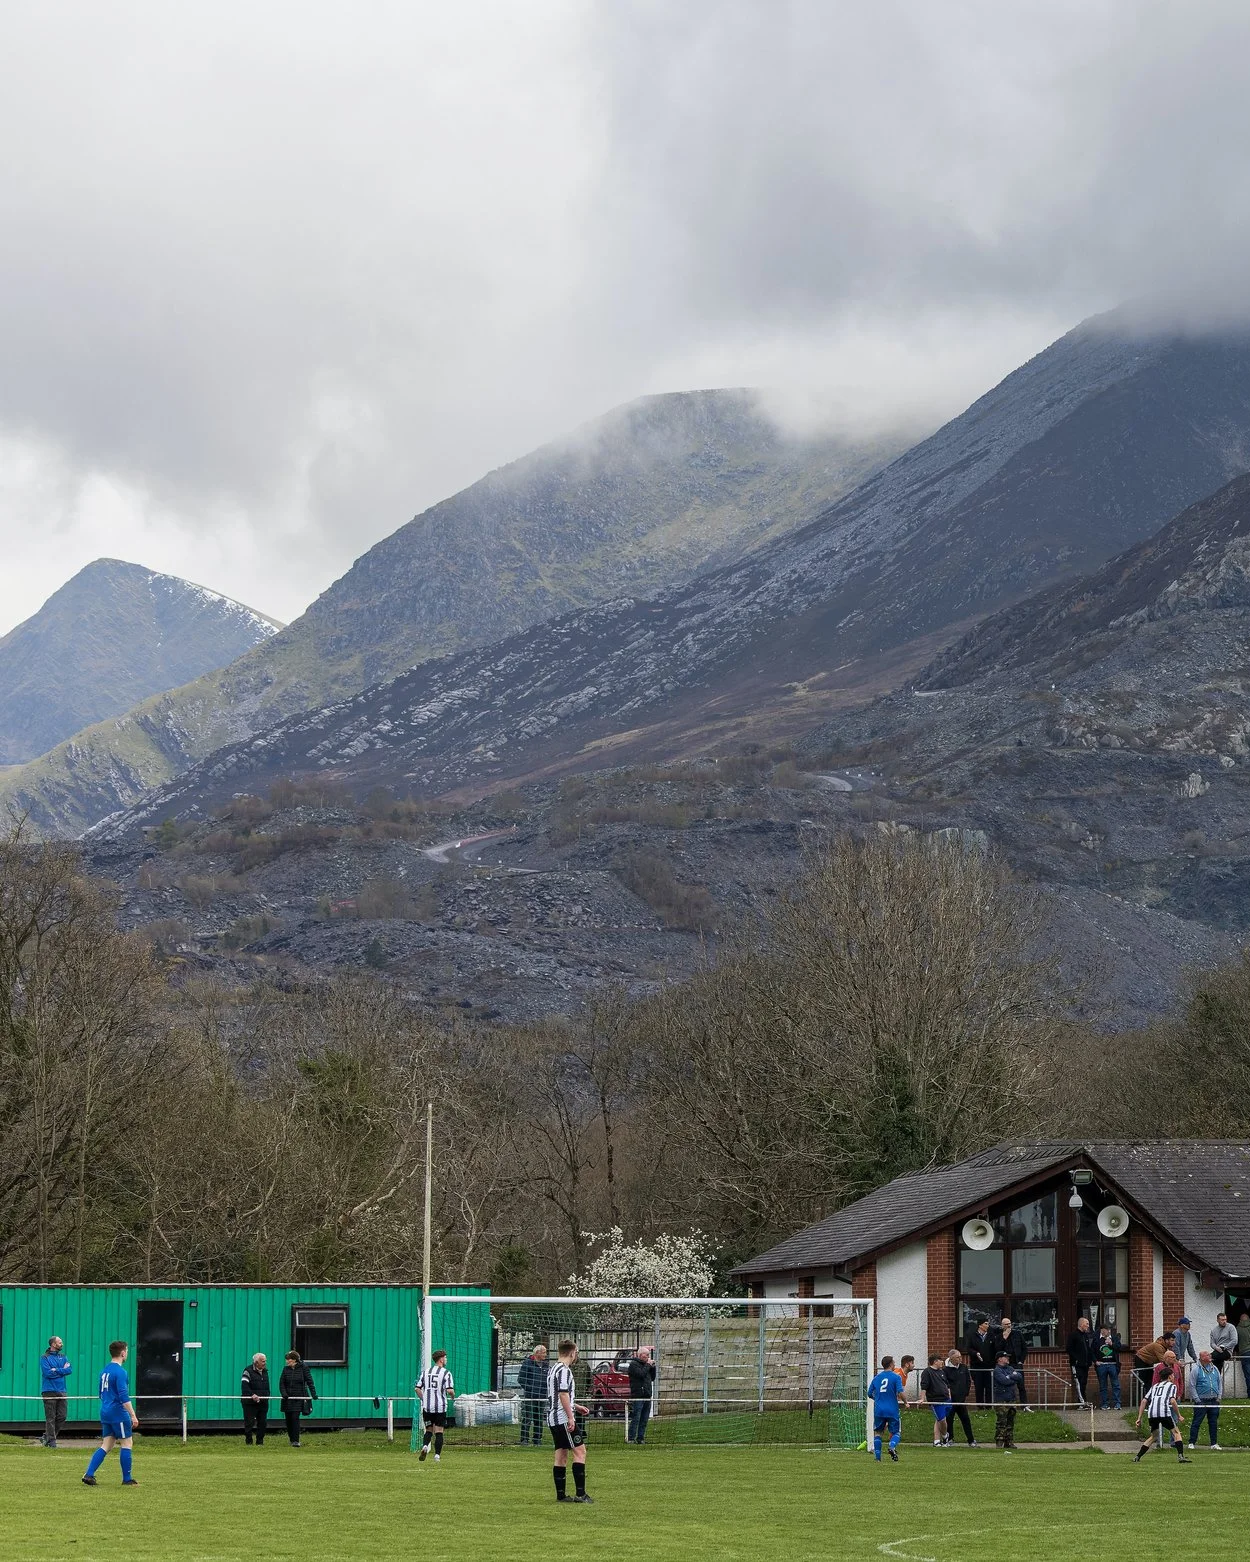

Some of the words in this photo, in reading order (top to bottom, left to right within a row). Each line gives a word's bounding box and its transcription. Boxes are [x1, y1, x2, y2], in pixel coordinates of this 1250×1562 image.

[100, 1373, 110, 1392] 14
[428, 1375, 438, 1389] 15
[880, 1378, 889, 1392] 2
[1154, 1386, 1164, 1397] 10
